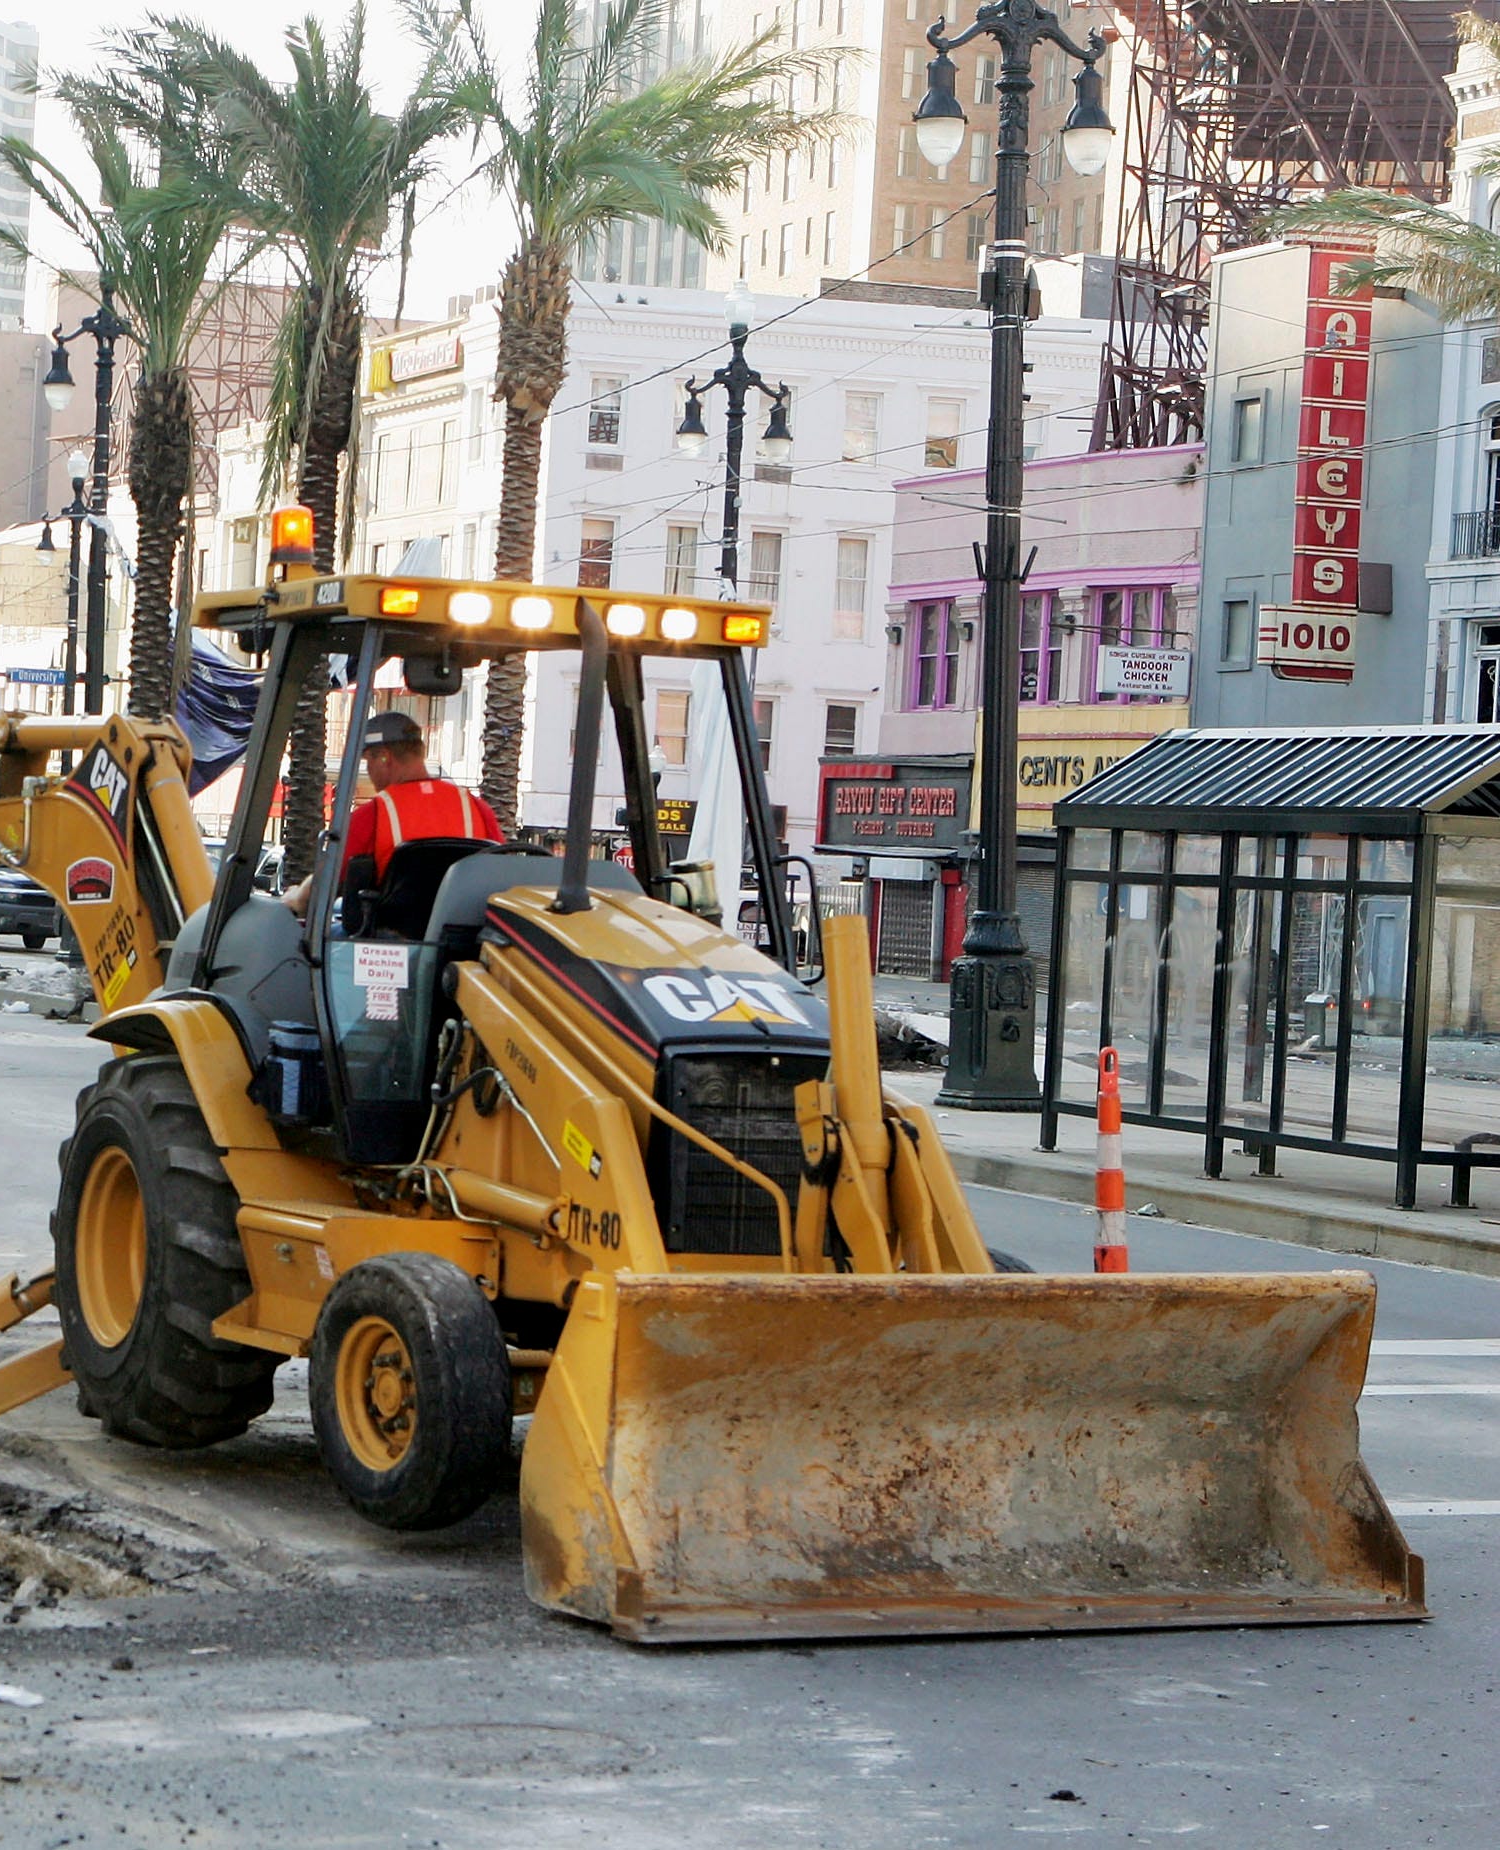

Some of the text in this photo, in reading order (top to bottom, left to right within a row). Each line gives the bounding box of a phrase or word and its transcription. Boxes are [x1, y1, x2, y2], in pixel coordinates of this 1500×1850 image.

[1280, 622, 1350, 652] 1010
[1121, 660, 1172, 671] TANDOORI
[18, 670, 57, 684] University
[1124, 672, 1168, 682] CHICKEN
[1117, 682, 1152, 690] Restaurant
[1019, 756, 1084, 786] CENTS
[90, 748, 128, 817] CAT
[664, 800, 691, 809] SELL
[835, 787, 956, 816] BAYOU GIFT CENTER
[658, 823, 687, 831] SALE
[616, 855, 635, 868] STO
[94, 914, 135, 989] TR-80
[362, 947, 400, 956] Grease
[359, 958, 404, 967] Machine
[368, 969, 395, 980] Daily
[372, 992, 390, 1001] FIRE
[643, 974, 812, 1029] CAT
[571, 1204, 621, 1250] TR-80
